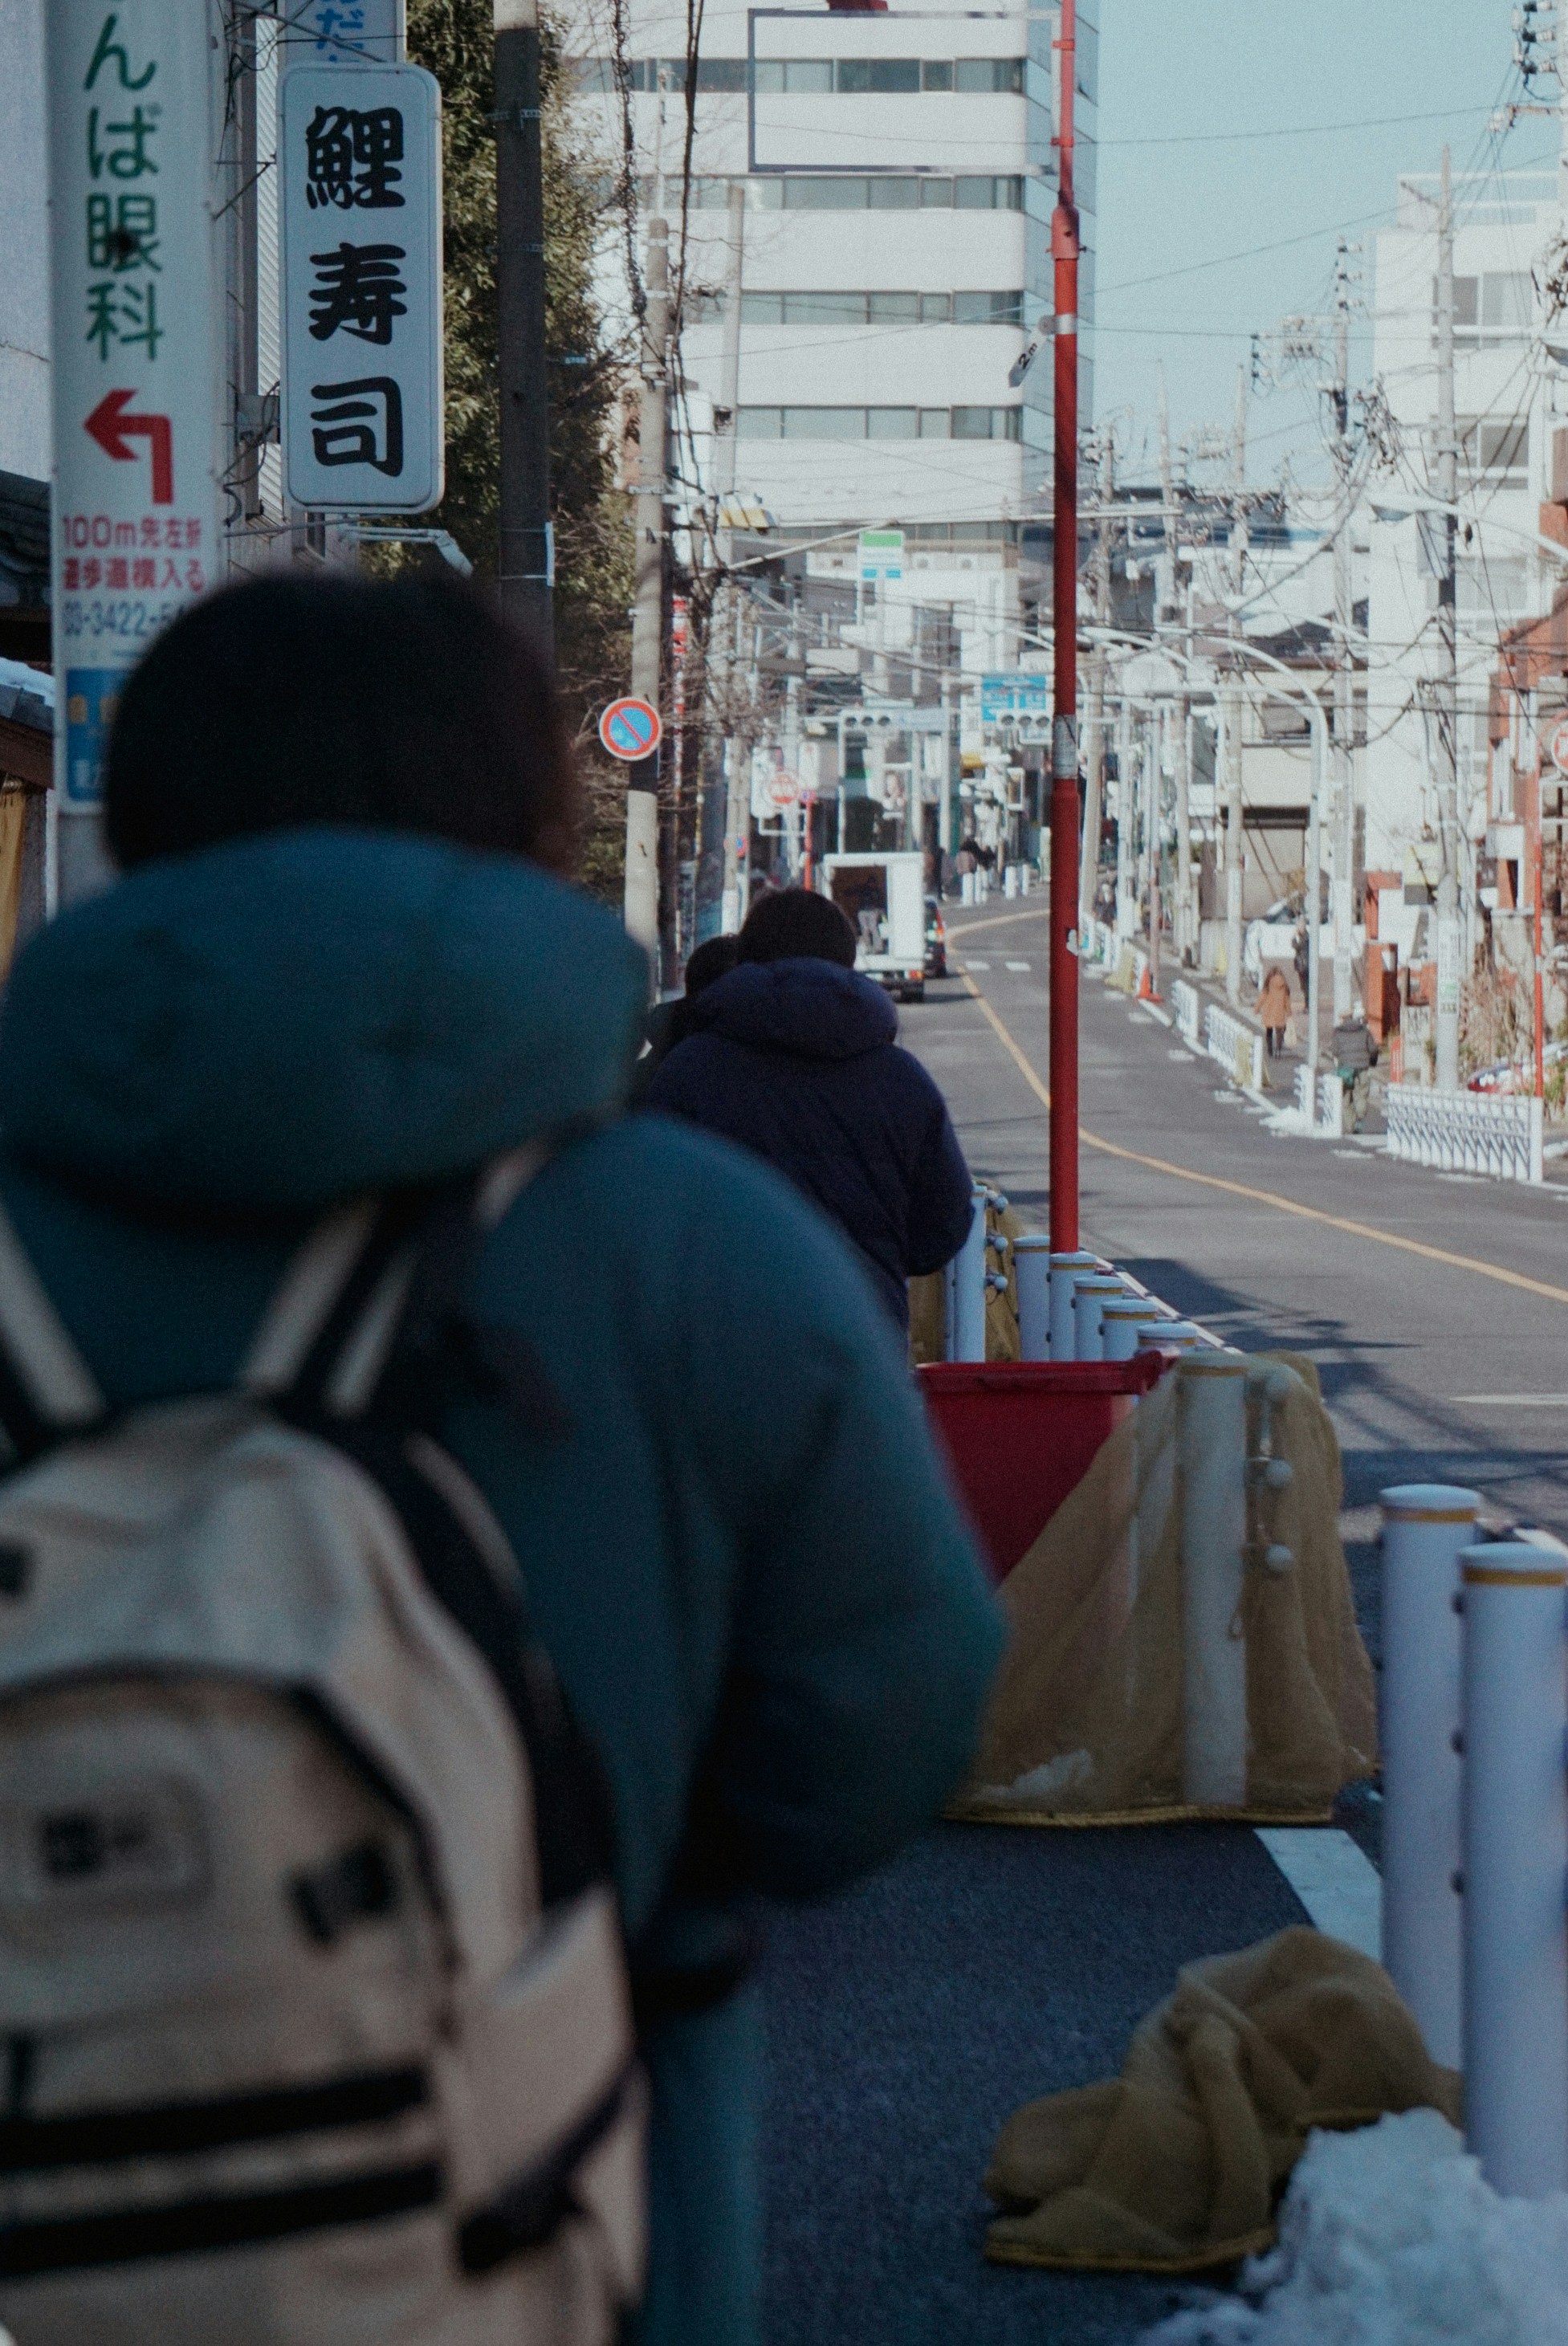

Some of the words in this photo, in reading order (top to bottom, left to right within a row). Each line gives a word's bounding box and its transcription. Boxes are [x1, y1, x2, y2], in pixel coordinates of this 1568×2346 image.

[83, 0, 164, 361] んば眼科
[305, 105, 408, 477] 鯉寿司
[1017, 342, 1038, 370] 2m
[63, 515, 202, 549] 100m先左折
